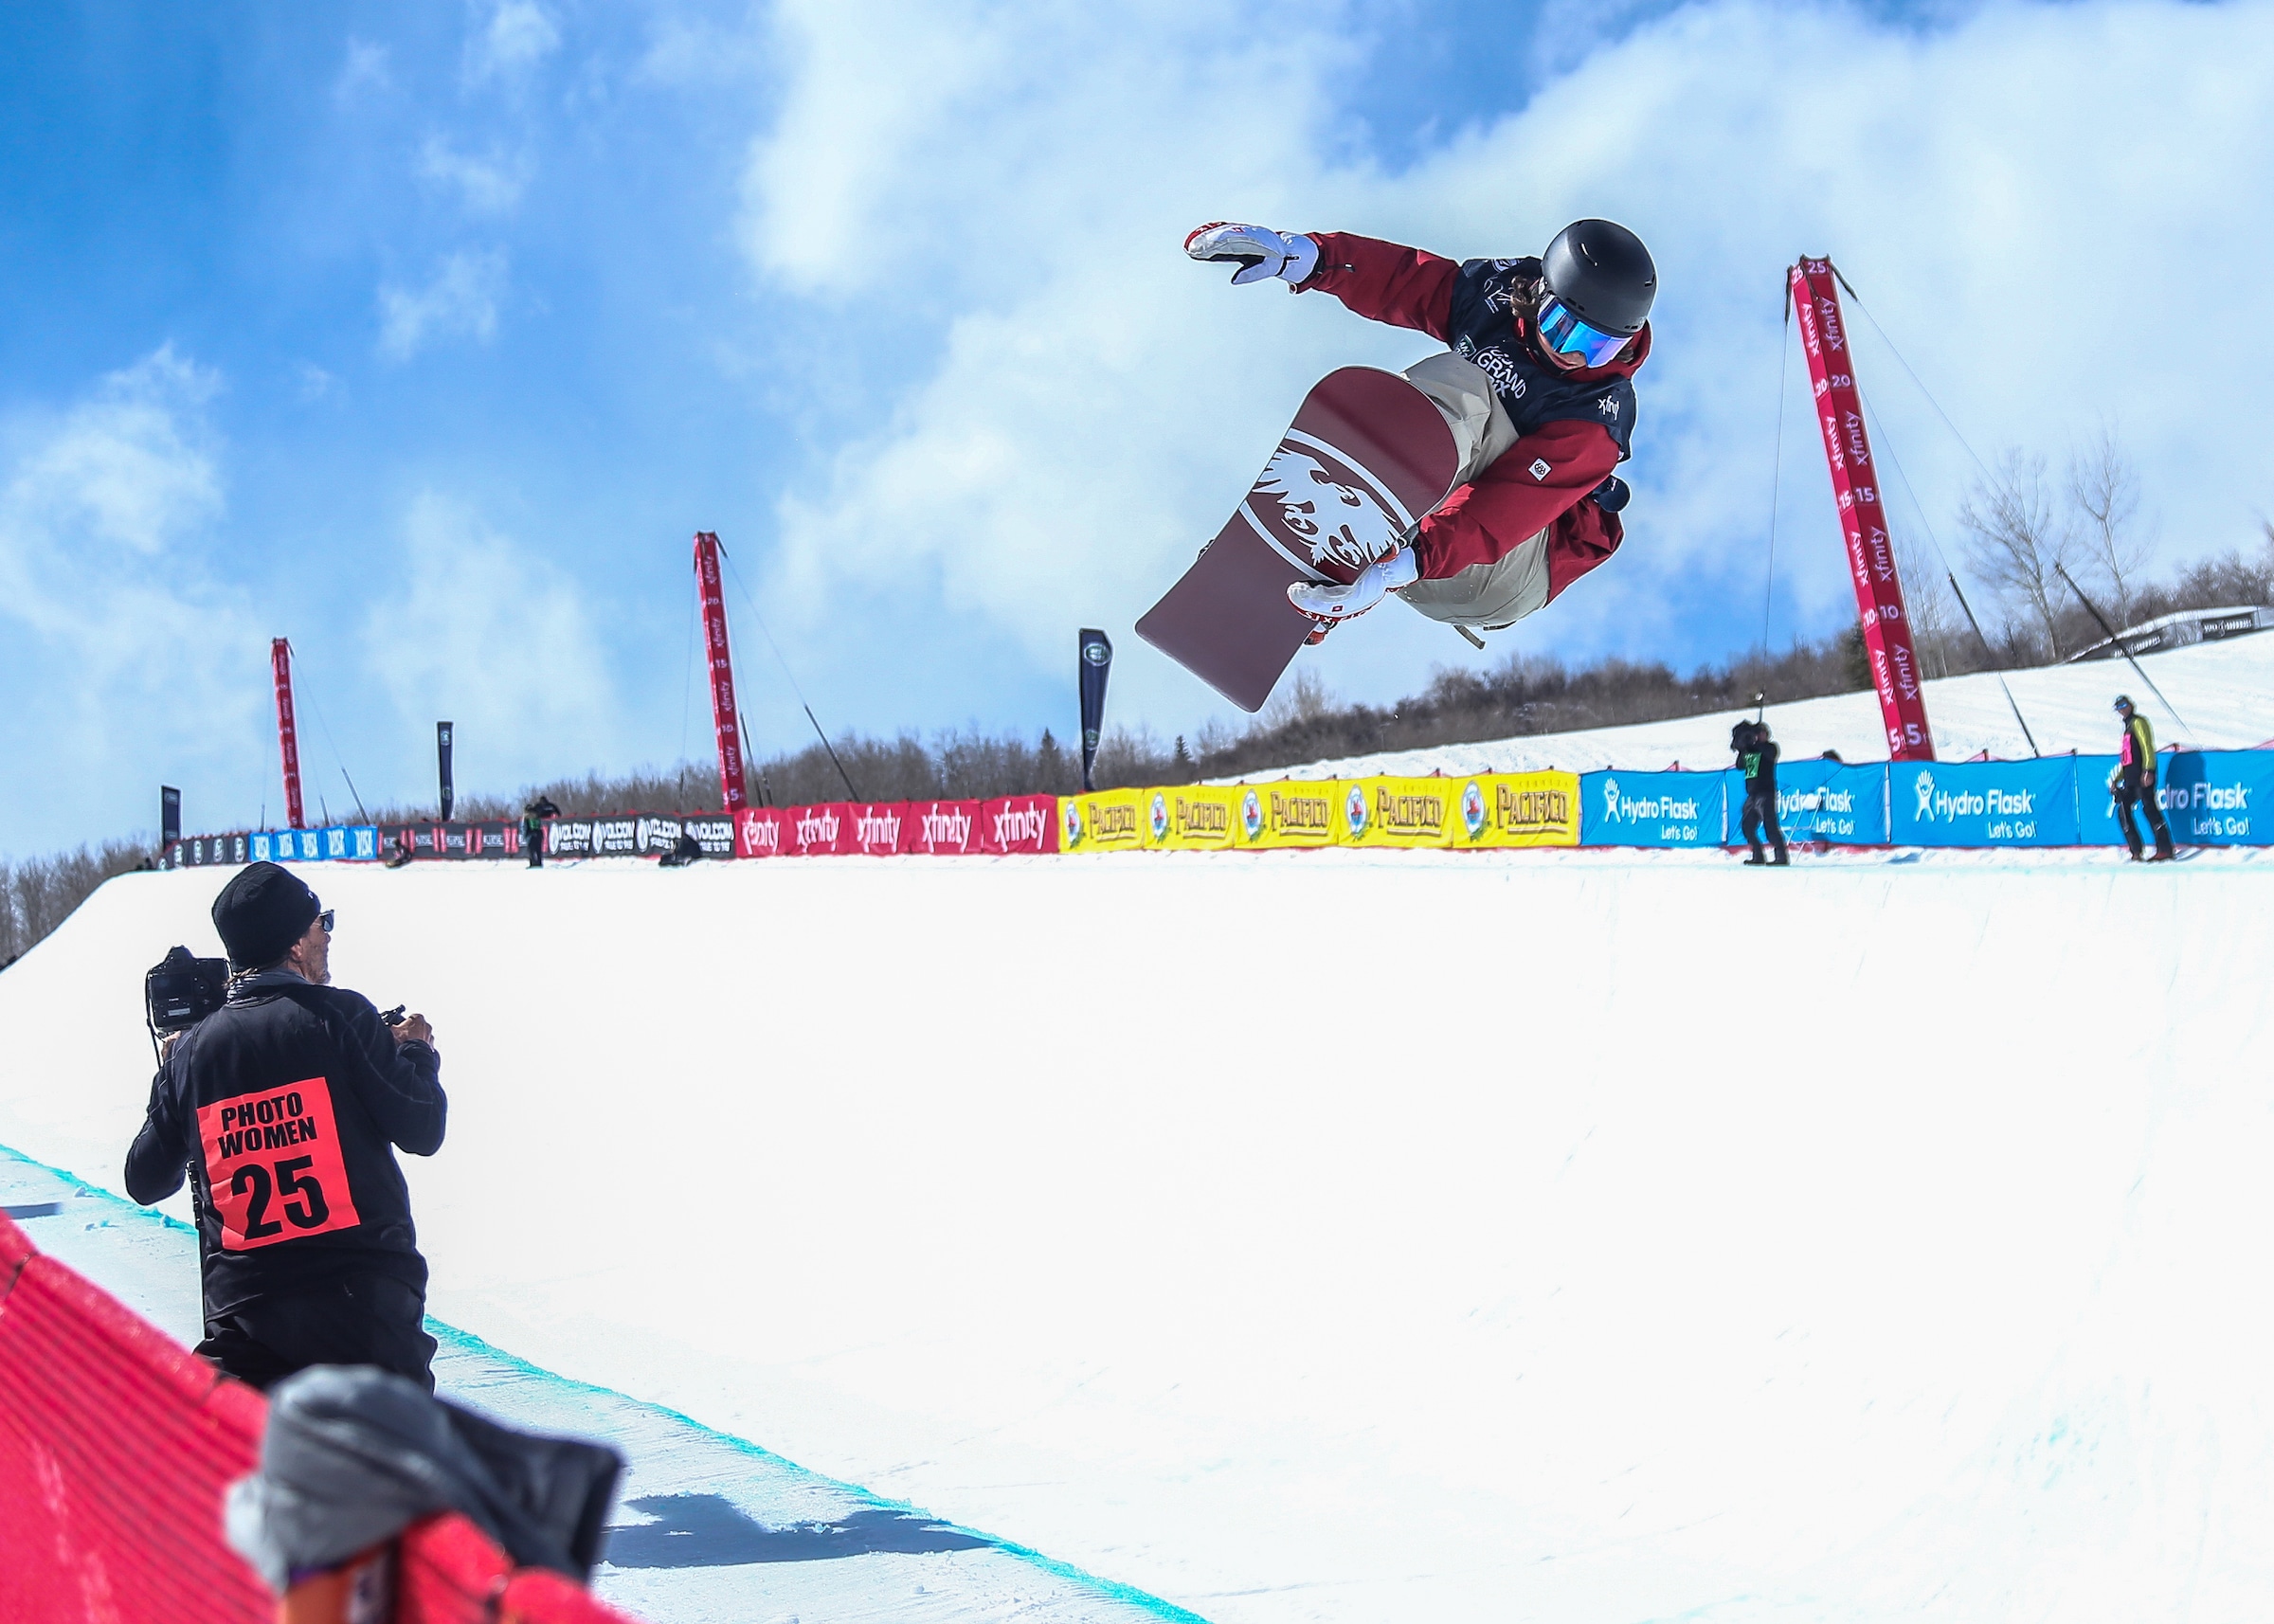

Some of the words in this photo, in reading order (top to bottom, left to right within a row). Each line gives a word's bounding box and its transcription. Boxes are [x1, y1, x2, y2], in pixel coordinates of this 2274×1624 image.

[1802, 303, 1820, 357] xfinity
[1821, 298, 1844, 351] xfinity
[1477, 352, 1526, 399] GRAND
[1827, 416, 1845, 471] xfinity
[1846, 410, 1869, 466] xfinity
[1850, 531, 1869, 586] xfinity
[1870, 526, 1894, 582] xfinity
[1874, 649, 1894, 705] xfinity
[1894, 644, 1919, 700] xfinity
[1176, 797, 1227, 835] PACIFICO
[1271, 791, 1328, 831] PACIFICO
[1377, 786, 1441, 828] PACIFICO
[1496, 785, 1569, 829] PACIFICO
[1621, 796, 1658, 824] Hydro
[1660, 796, 1698, 820] Flask
[1936, 790, 1984, 822] Hydro
[1988, 789, 2032, 815] Flask
[2193, 782, 2248, 810] Flask
[797, 808, 840, 853] xfinity
[857, 806, 901, 853] xfinity
[921, 803, 971, 853] xfinity
[993, 801, 1047, 853] xfinity
[1089, 803, 1136, 839] PACIFICO
[1661, 824, 1681, 840] Let's
[1683, 825, 1697, 841] Go!
[1816, 817, 1836, 834] Let's
[1989, 821, 2012, 839] Let's
[2015, 821, 2036, 839] Go!
[2193, 818, 2222, 836] Let's
[2226, 818, 2250, 836] Go!
[222, 1092, 303, 1131] PHOTO
[217, 1116, 317, 1160] WOMEN
[230, 1154, 330, 1240] 25
